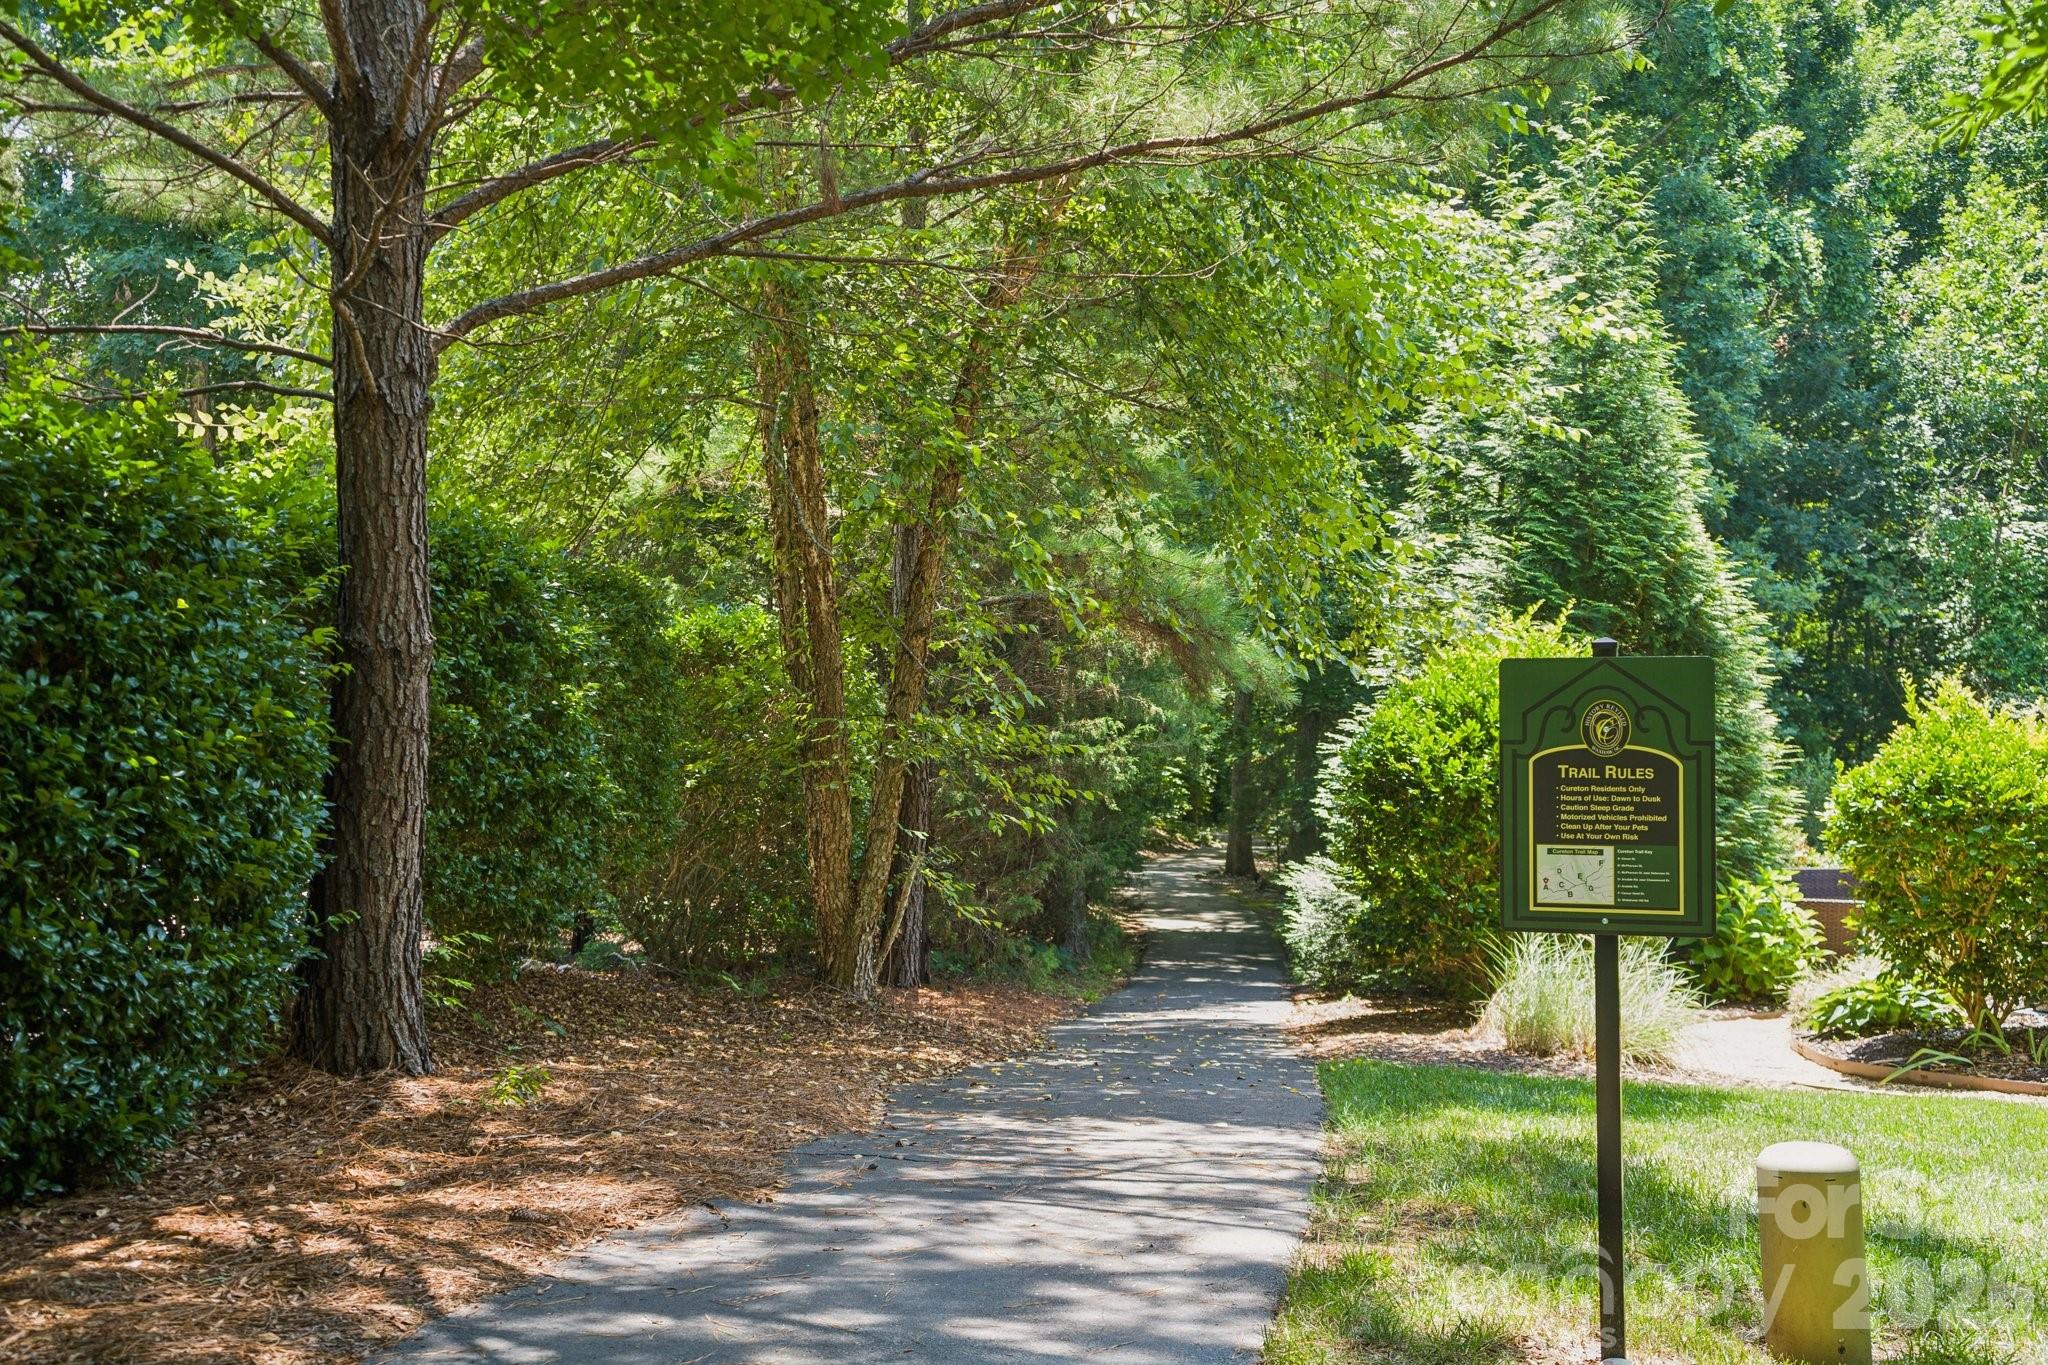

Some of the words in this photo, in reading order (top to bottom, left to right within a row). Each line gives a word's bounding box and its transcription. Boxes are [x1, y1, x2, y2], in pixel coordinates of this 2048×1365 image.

[1584, 704, 1605, 727] HISTORY
[1606, 704, 1628, 727] REVIVED
[1628, 785, 1646, 794] Only
[1642, 795, 1661, 803] Dusk
[1560, 803, 1589, 811] Caution
[1590, 804, 1611, 813] Steep
[1612, 804, 1635, 812] Grade
[1560, 813, 1596, 821] Motorized
[1629, 814, 1668, 822] Prohibited
[1560, 822, 1582, 830] Clean
[1582, 823, 1594, 831] Up
[1632, 824, 1649, 832] Pets
[1560, 832, 1575, 840] Use
[1575, 832, 1585, 840] At
[1603, 833, 1621, 841] Own
[1622, 833, 1639, 841] Risk
[1567, 890, 1574, 898] B
